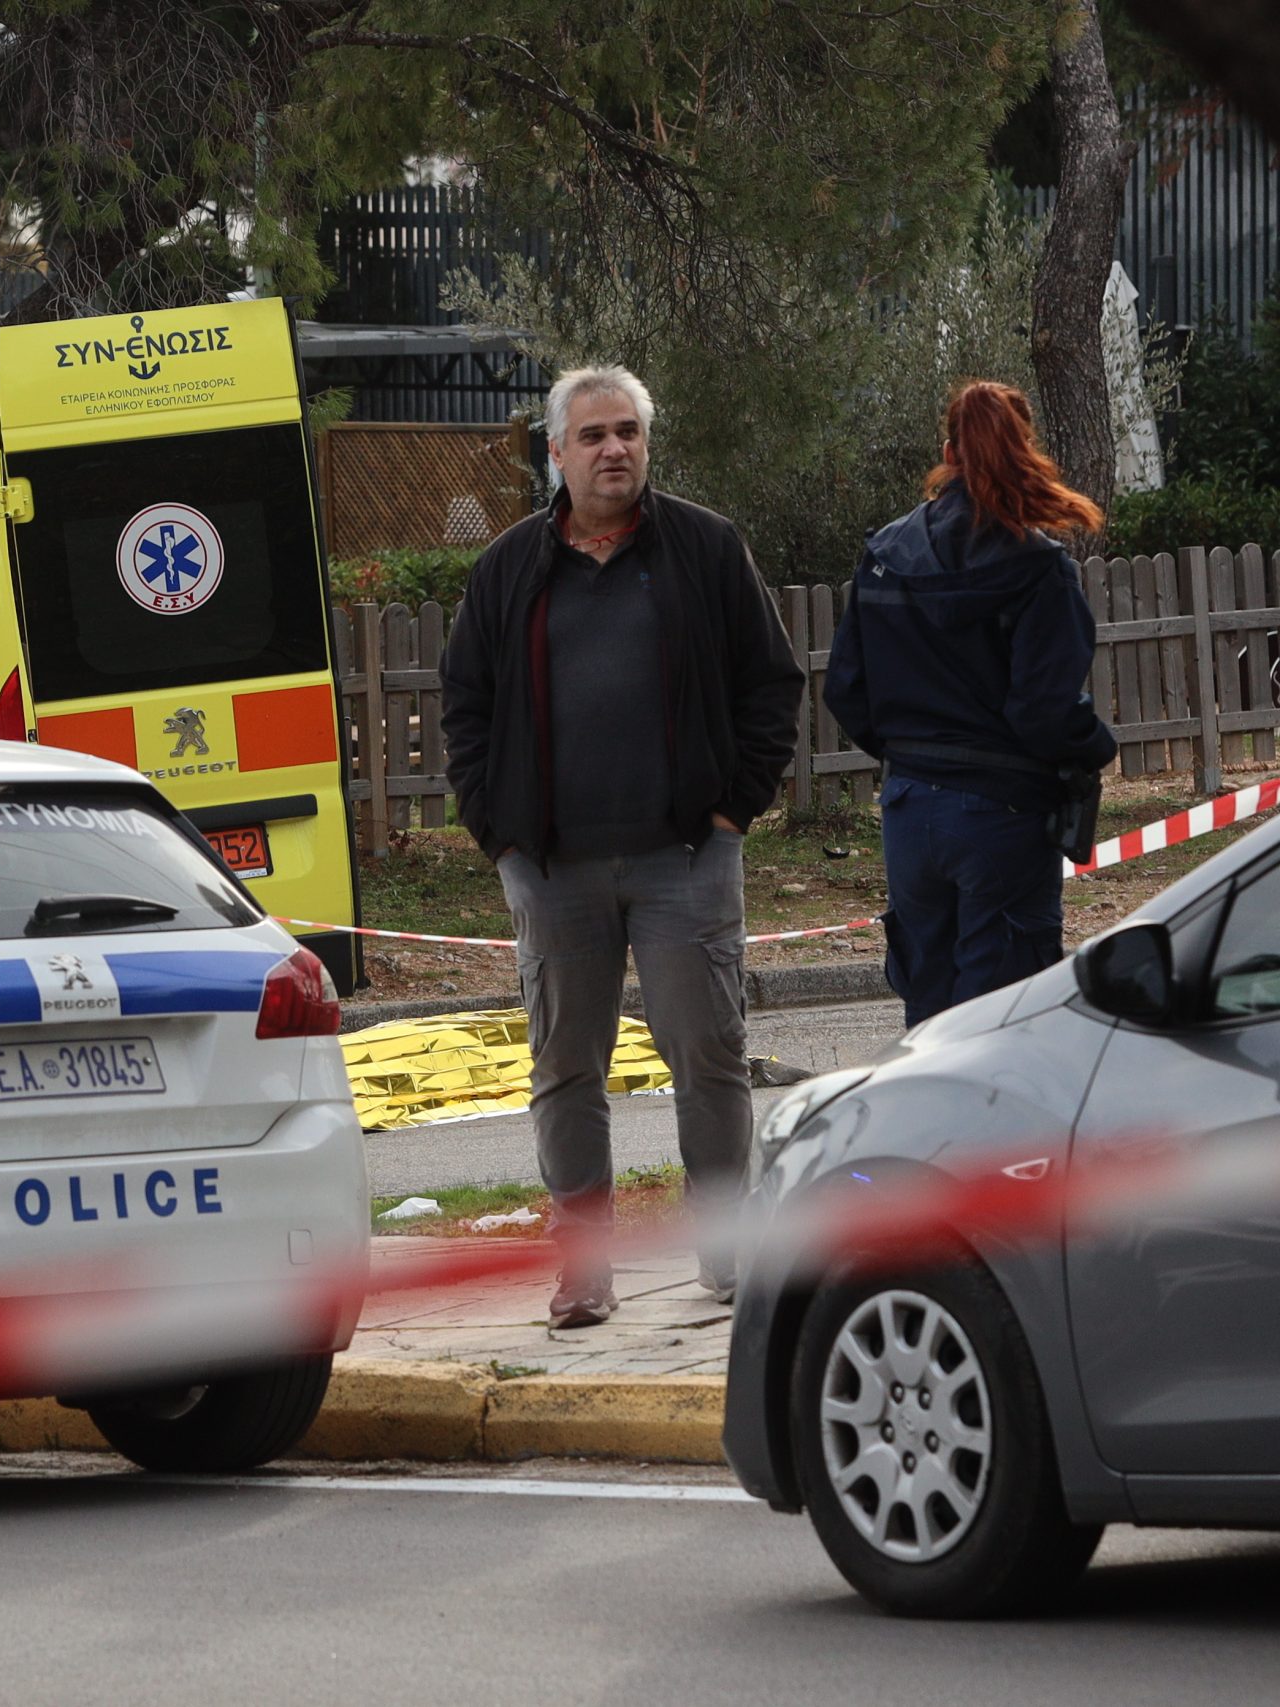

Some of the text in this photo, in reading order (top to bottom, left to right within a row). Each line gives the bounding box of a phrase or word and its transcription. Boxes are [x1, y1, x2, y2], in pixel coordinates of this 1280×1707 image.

[60, 376, 236, 405] ΕΤΑΙΡΕΙΑ ΚΟΙΝΩΝΙΚΗΣ ΠΡΟΣΦΟΡΑΣ
[85, 392, 215, 415] ΕΛΛΗΝΙΚΟΥ ΕΦΟΠΛΙΣΜΟΥ
[141, 761, 236, 779] PEUGEOT
[43, 997, 118, 1011] PEUGEOT
[59, 1044, 145, 1088] 31845
